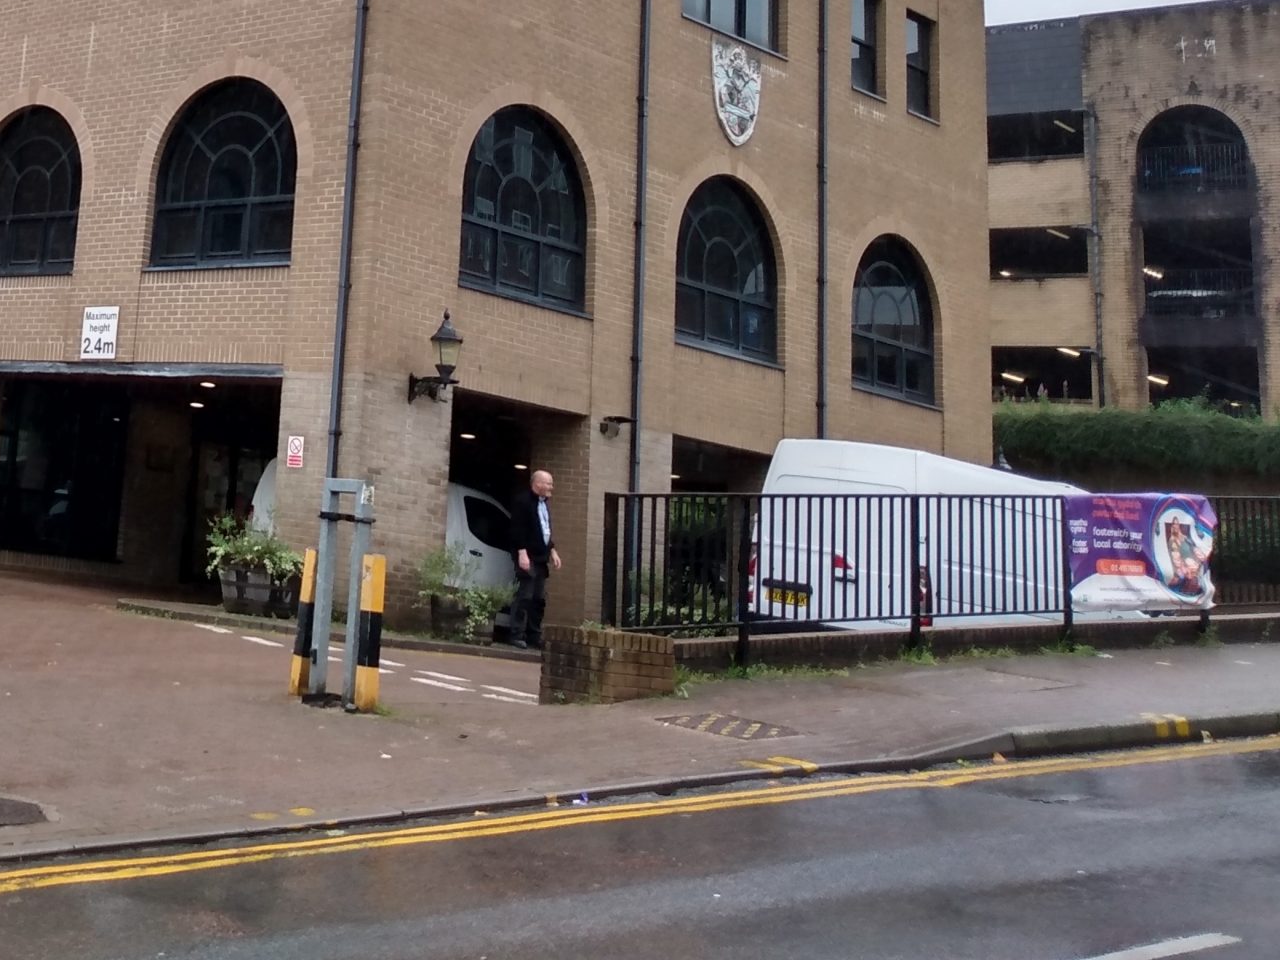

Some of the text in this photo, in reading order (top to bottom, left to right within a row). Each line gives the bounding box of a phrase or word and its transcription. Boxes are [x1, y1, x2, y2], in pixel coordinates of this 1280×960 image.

[85, 311, 117, 320] Maximum
[89, 323, 111, 334] height
[82, 337, 114, 354] 2.4m
